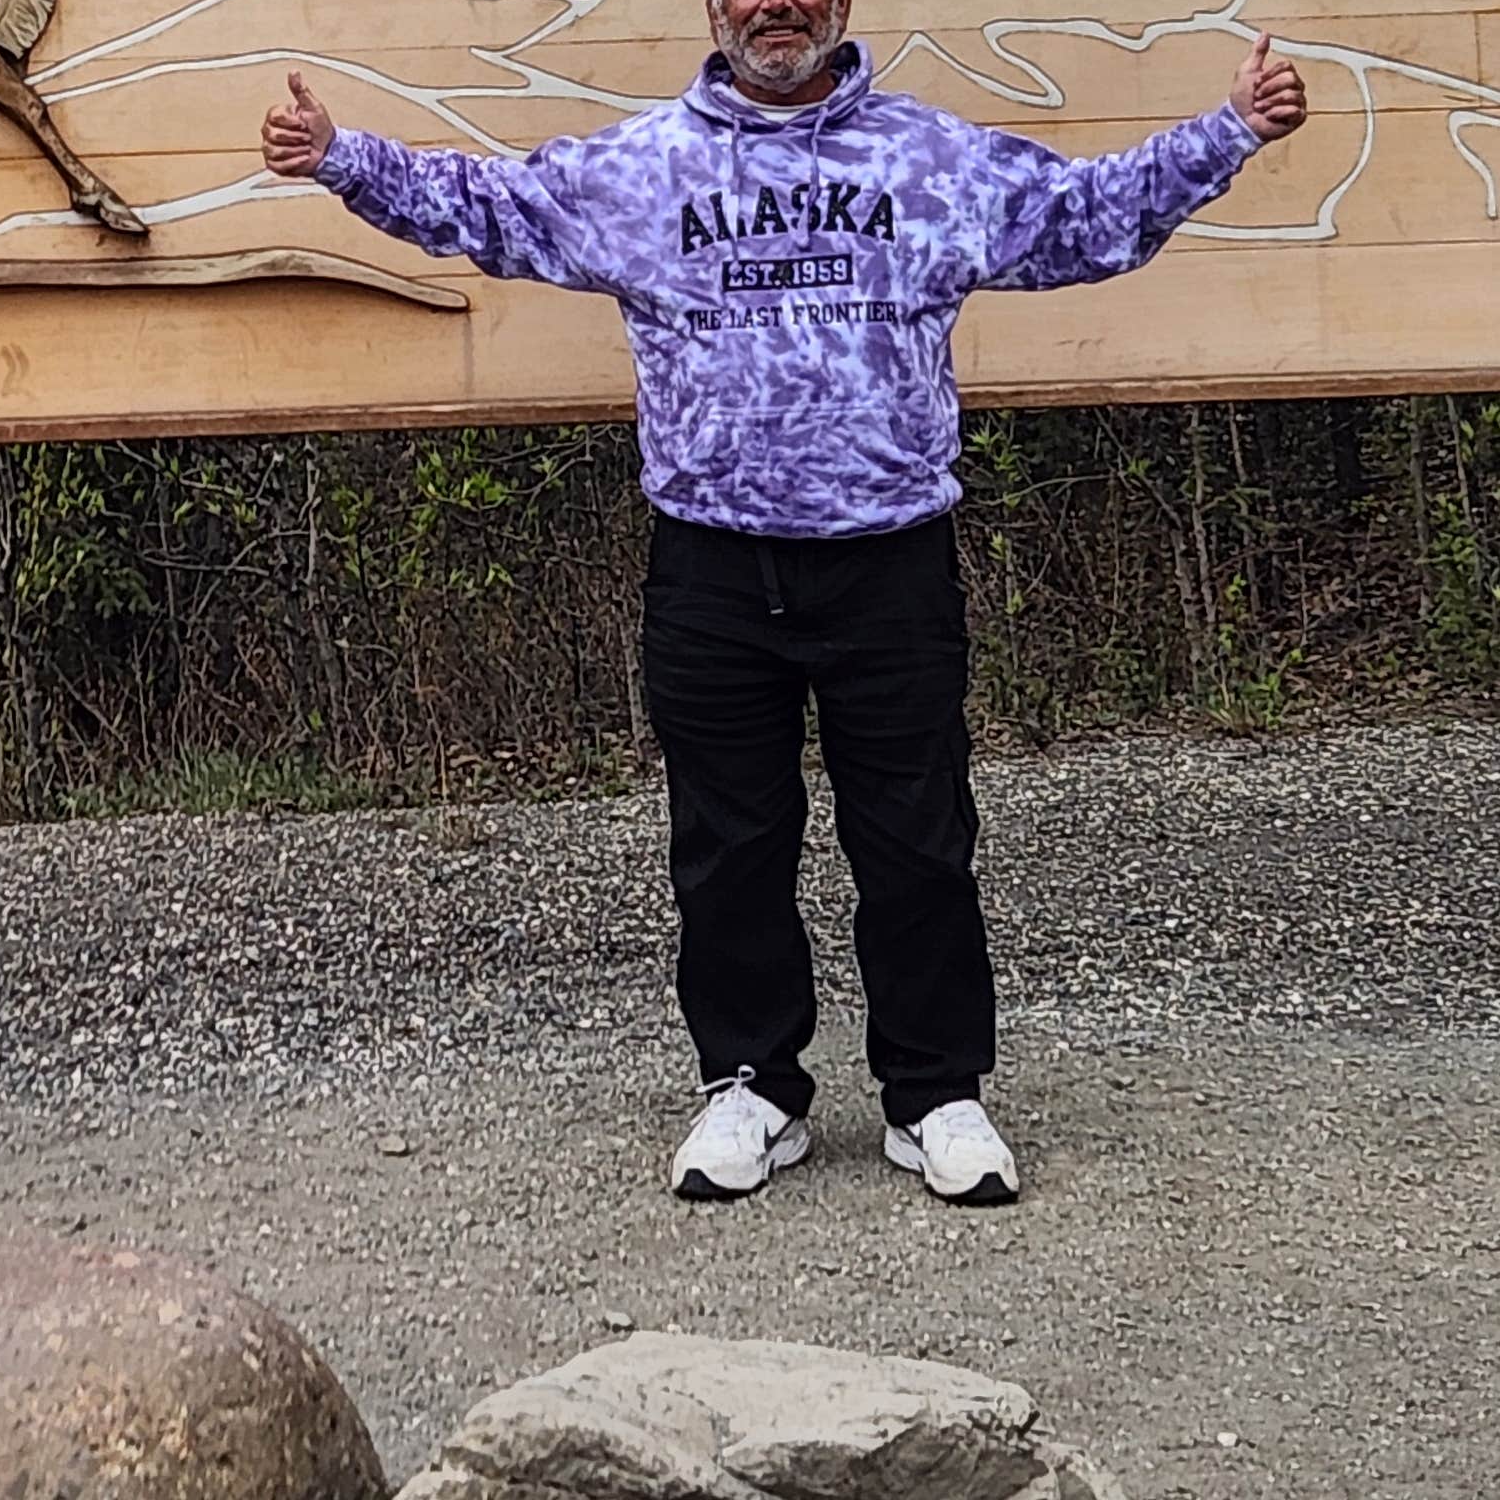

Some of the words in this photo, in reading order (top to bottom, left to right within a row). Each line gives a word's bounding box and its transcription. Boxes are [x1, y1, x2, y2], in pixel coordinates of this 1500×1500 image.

[681, 183, 895, 256] ALASKA
[728, 262, 781, 287] EST.
[792, 258, 848, 285] 1959
[684, 308, 722, 334] THE
[728, 306, 782, 330] LAST
[792, 301, 898, 326] FRONTIER
